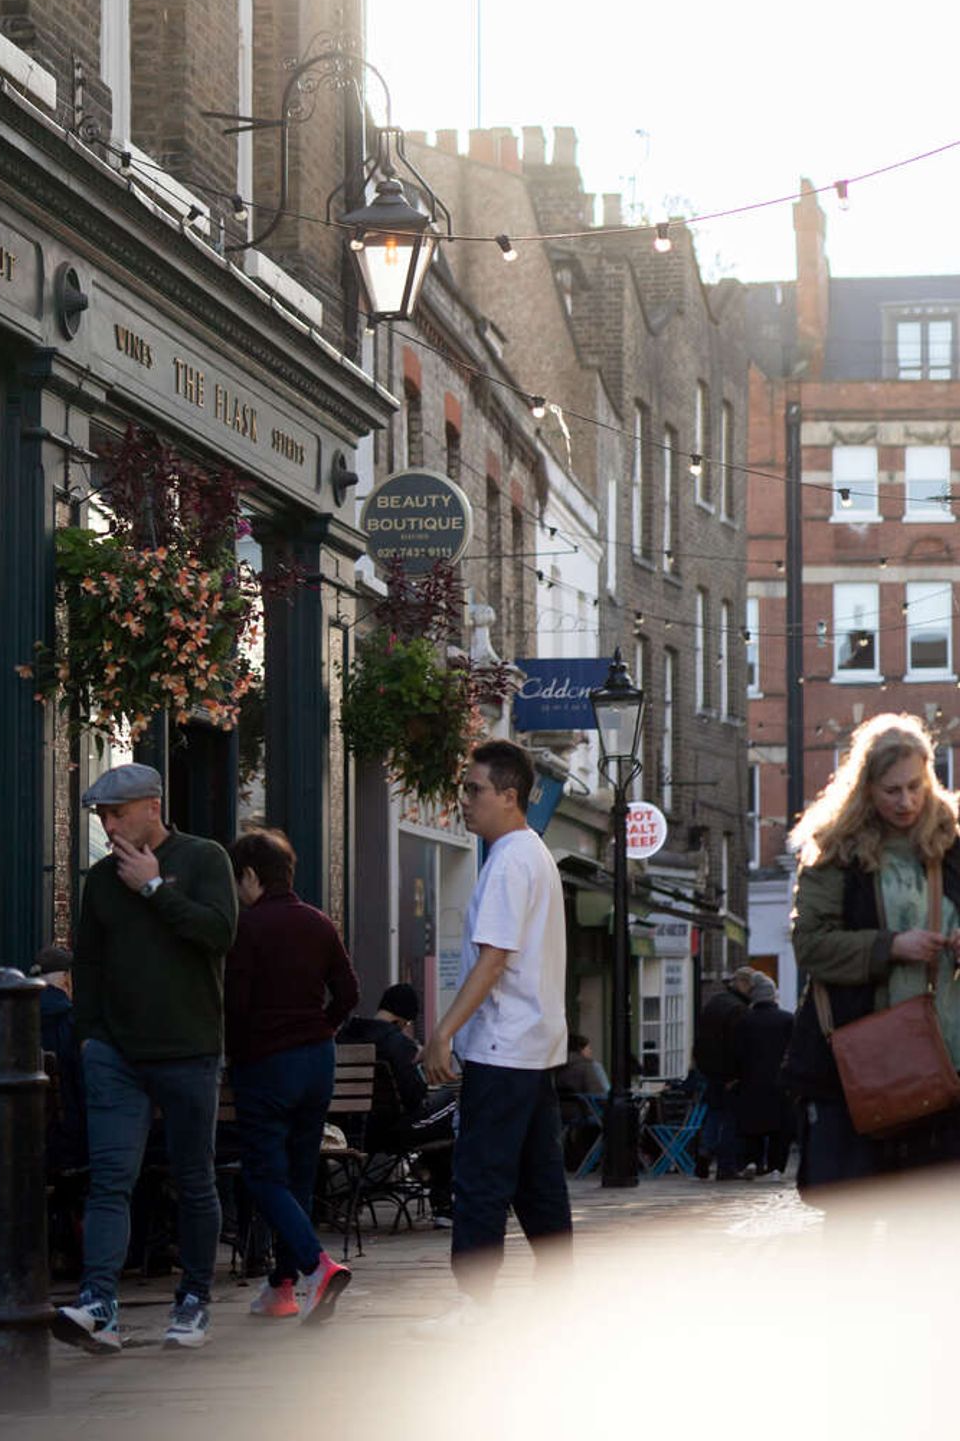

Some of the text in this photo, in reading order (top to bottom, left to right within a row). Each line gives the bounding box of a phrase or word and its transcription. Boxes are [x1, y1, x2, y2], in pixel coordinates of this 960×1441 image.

[114, 323, 153, 369] WINES
[173, 357, 205, 409] THE
[215, 383, 257, 444] FLASK
[376, 495, 453, 509] BEAUTY
[367, 517, 464, 531] BOUTIQUE
[626, 823, 657, 833] ALT
[626, 835, 657, 848] EEF
